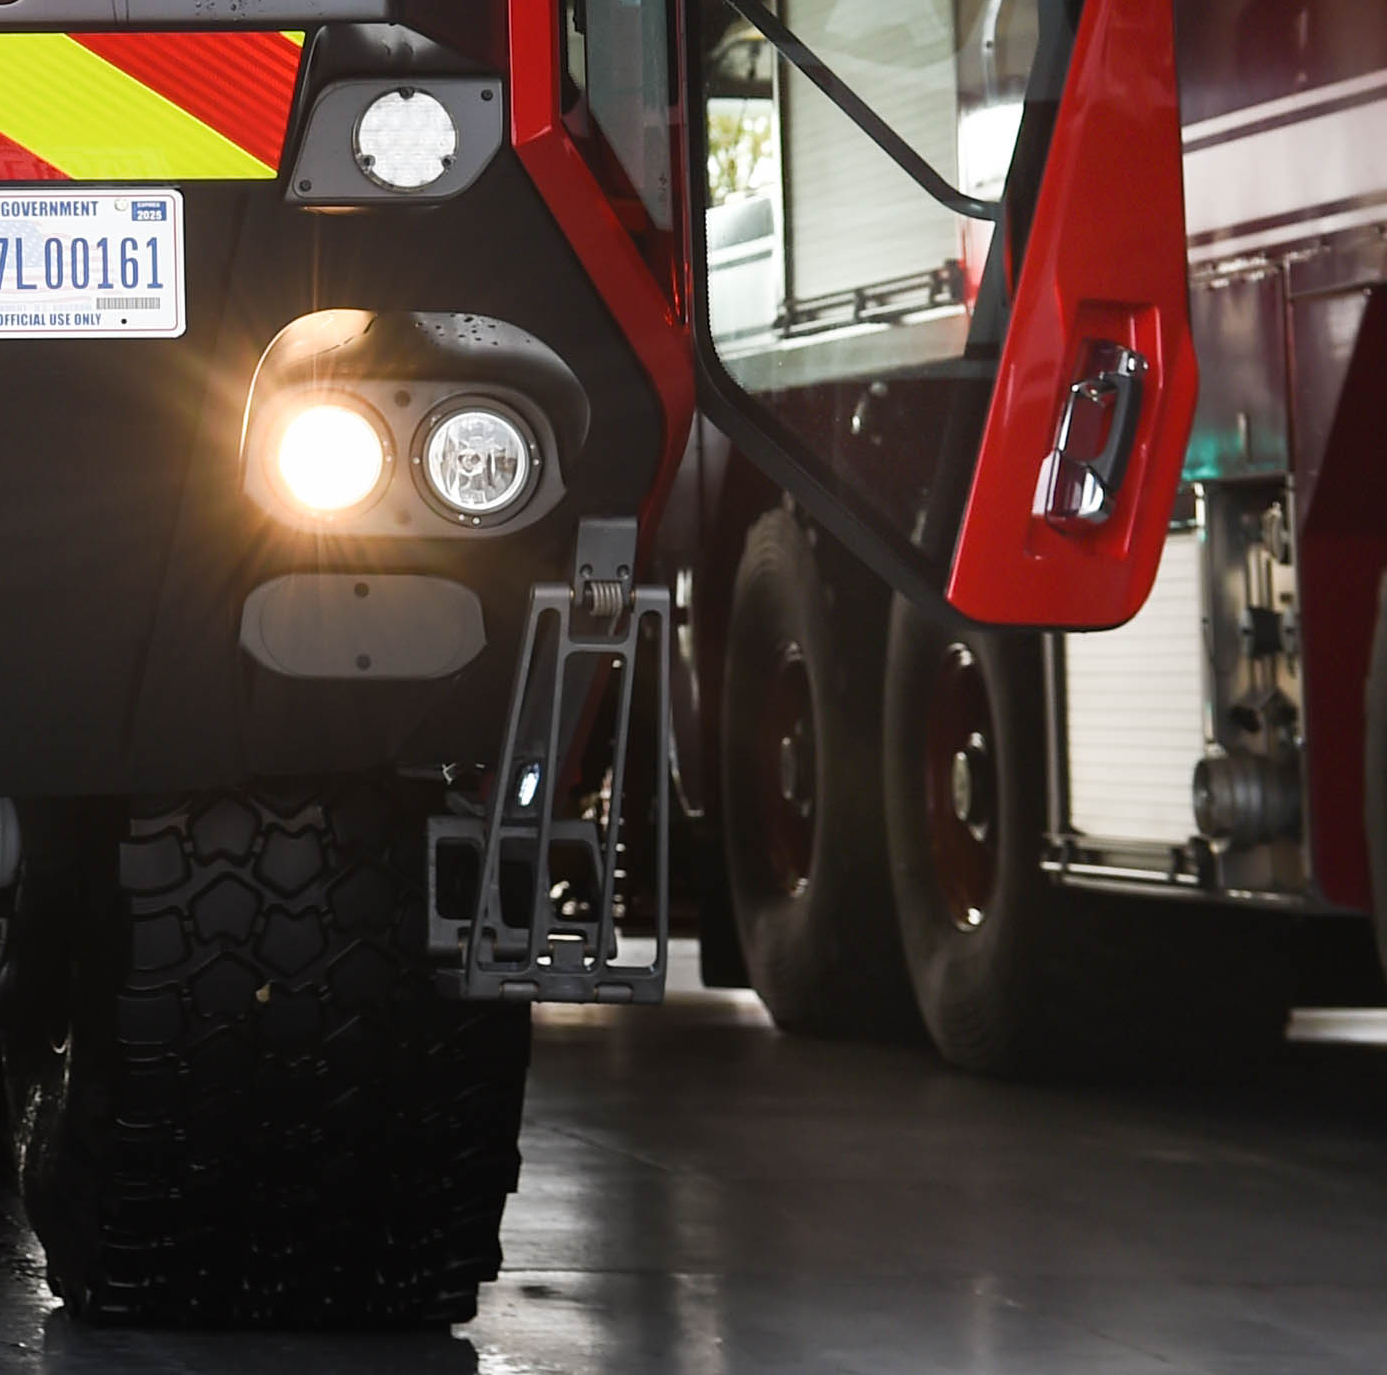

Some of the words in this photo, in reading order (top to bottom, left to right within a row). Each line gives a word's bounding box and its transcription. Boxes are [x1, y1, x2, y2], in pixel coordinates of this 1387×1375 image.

[1, 200, 99, 217] GOVERNMENT
[49, 313, 71, 326] USE
[74, 313, 102, 326] ONLY
